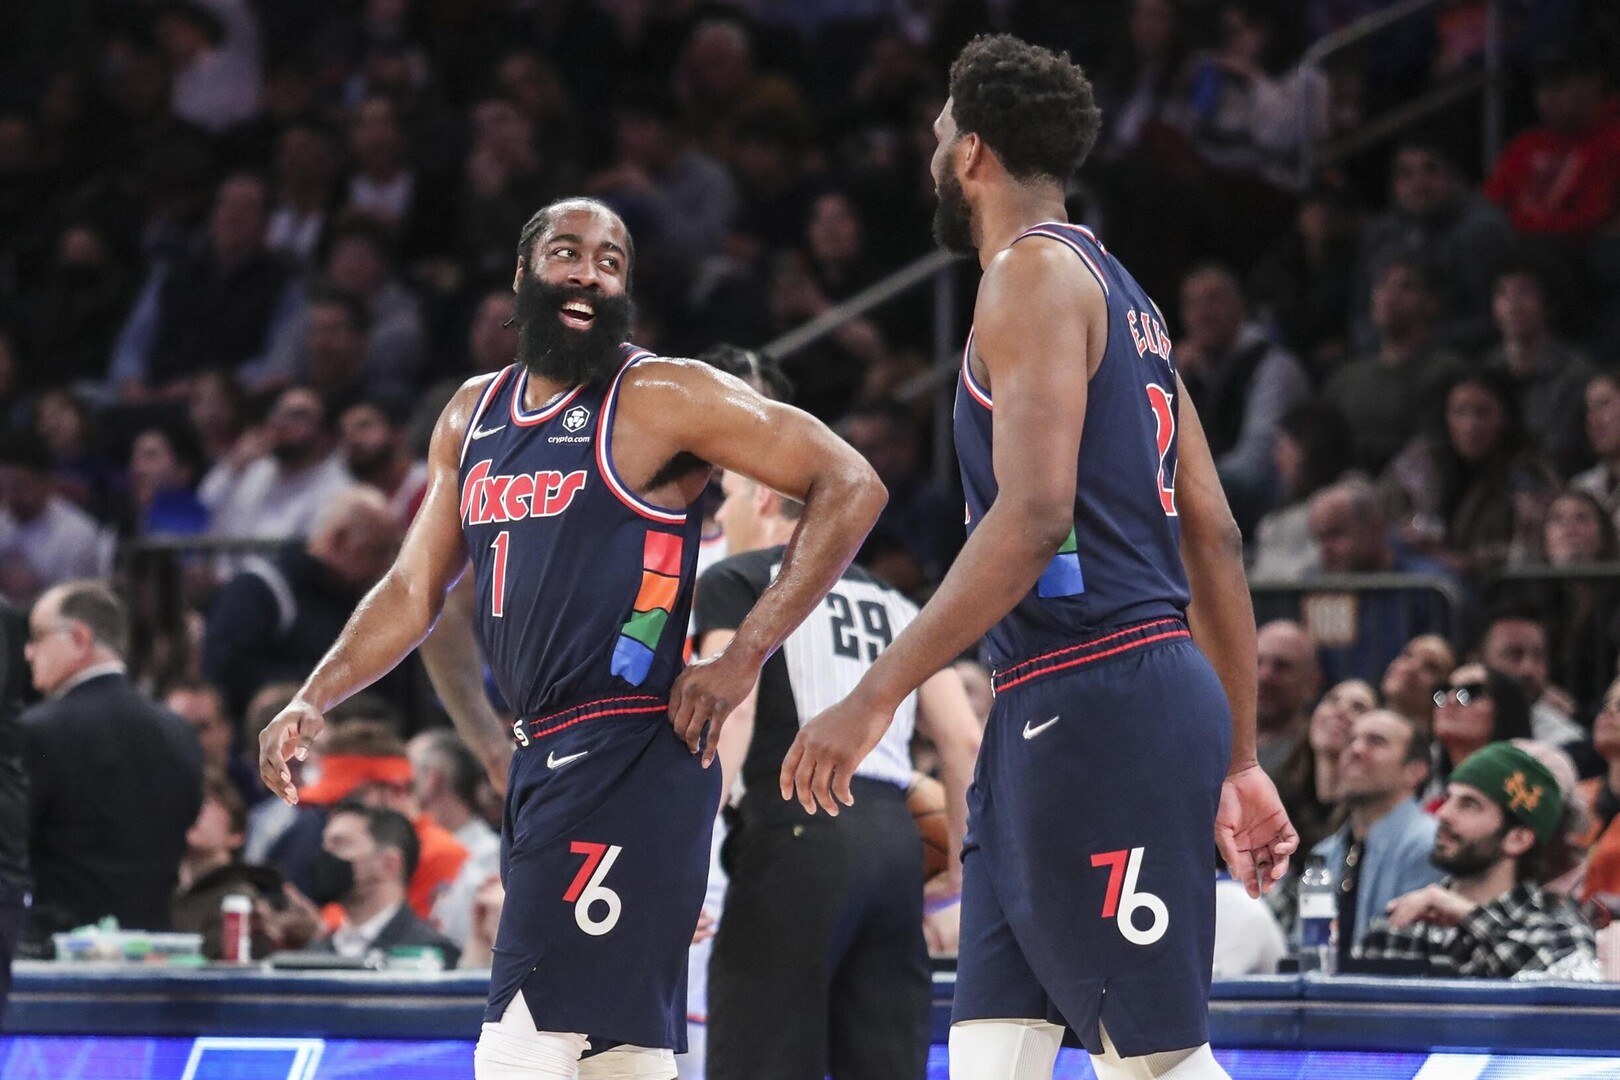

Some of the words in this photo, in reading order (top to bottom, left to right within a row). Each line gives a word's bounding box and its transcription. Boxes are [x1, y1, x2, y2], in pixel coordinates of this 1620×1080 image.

[548, 435, 590, 444] crypto.com
[490, 530, 510, 617] 1
[826, 592, 893, 662] 29
[562, 841, 622, 937] 76
[1090, 846, 1169, 946] 76
